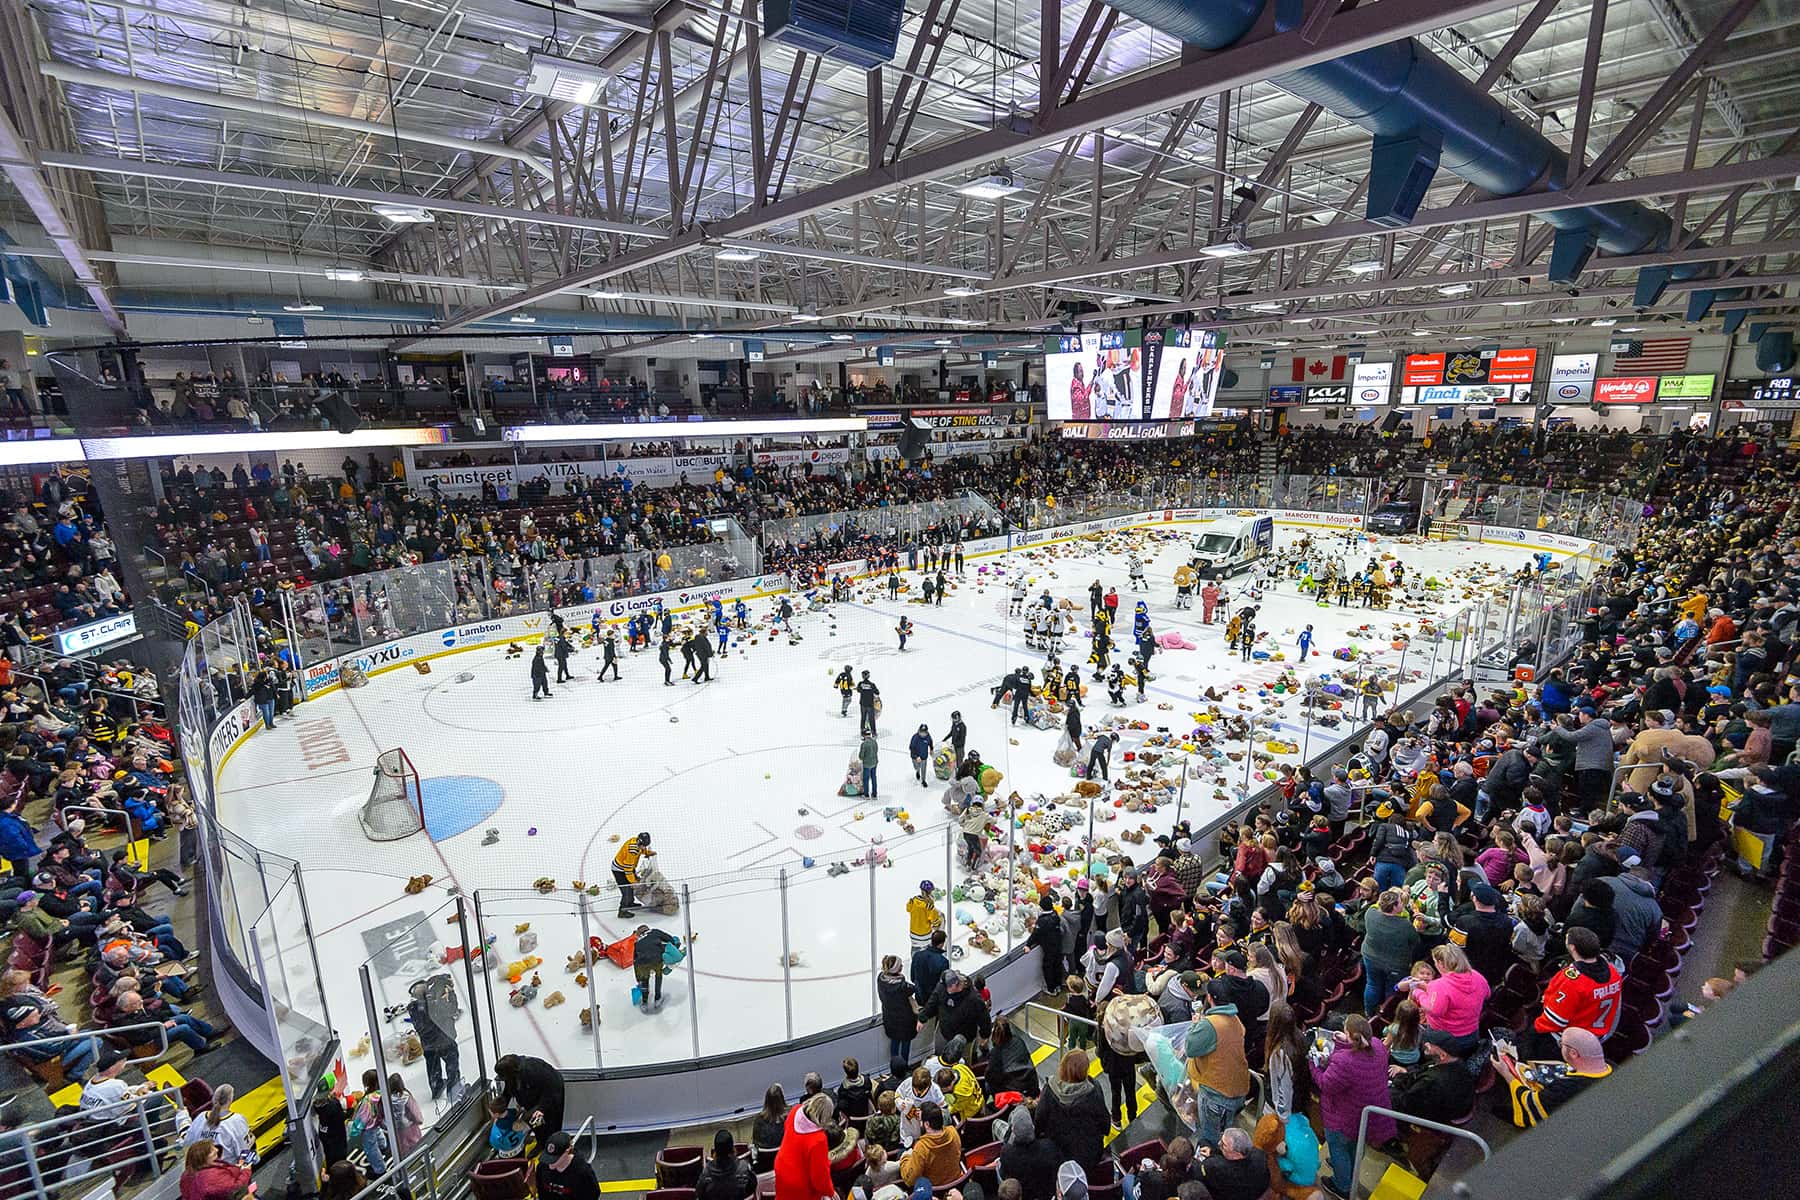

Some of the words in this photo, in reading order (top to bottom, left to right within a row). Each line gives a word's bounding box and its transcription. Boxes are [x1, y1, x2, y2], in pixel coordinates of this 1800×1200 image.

[1145, 345, 1155, 405] CARPENTERS
[1358, 373, 1387, 382] Imperial
[1556, 366, 1591, 376] Imperial
[1420, 387, 1462, 403] finch
[939, 416, 952, 427] OF
[953, 415, 977, 427] STING
[1108, 423, 1141, 439] GOAL!
[1141, 424, 1167, 439] GOAL!
[675, 457, 696, 466] UBC
[703, 456, 727, 465] BUILT
[543, 463, 584, 476] VITAL
[763, 577, 783, 588] kent
[690, 587, 733, 601] AINSWORTH
[100, 618, 131, 634] CLAIR
[459, 624, 501, 637] Lambton
[309, 663, 333, 679] Mary
[1555, 991, 1566, 1003] 7
[1593, 998, 1613, 1028] 7
